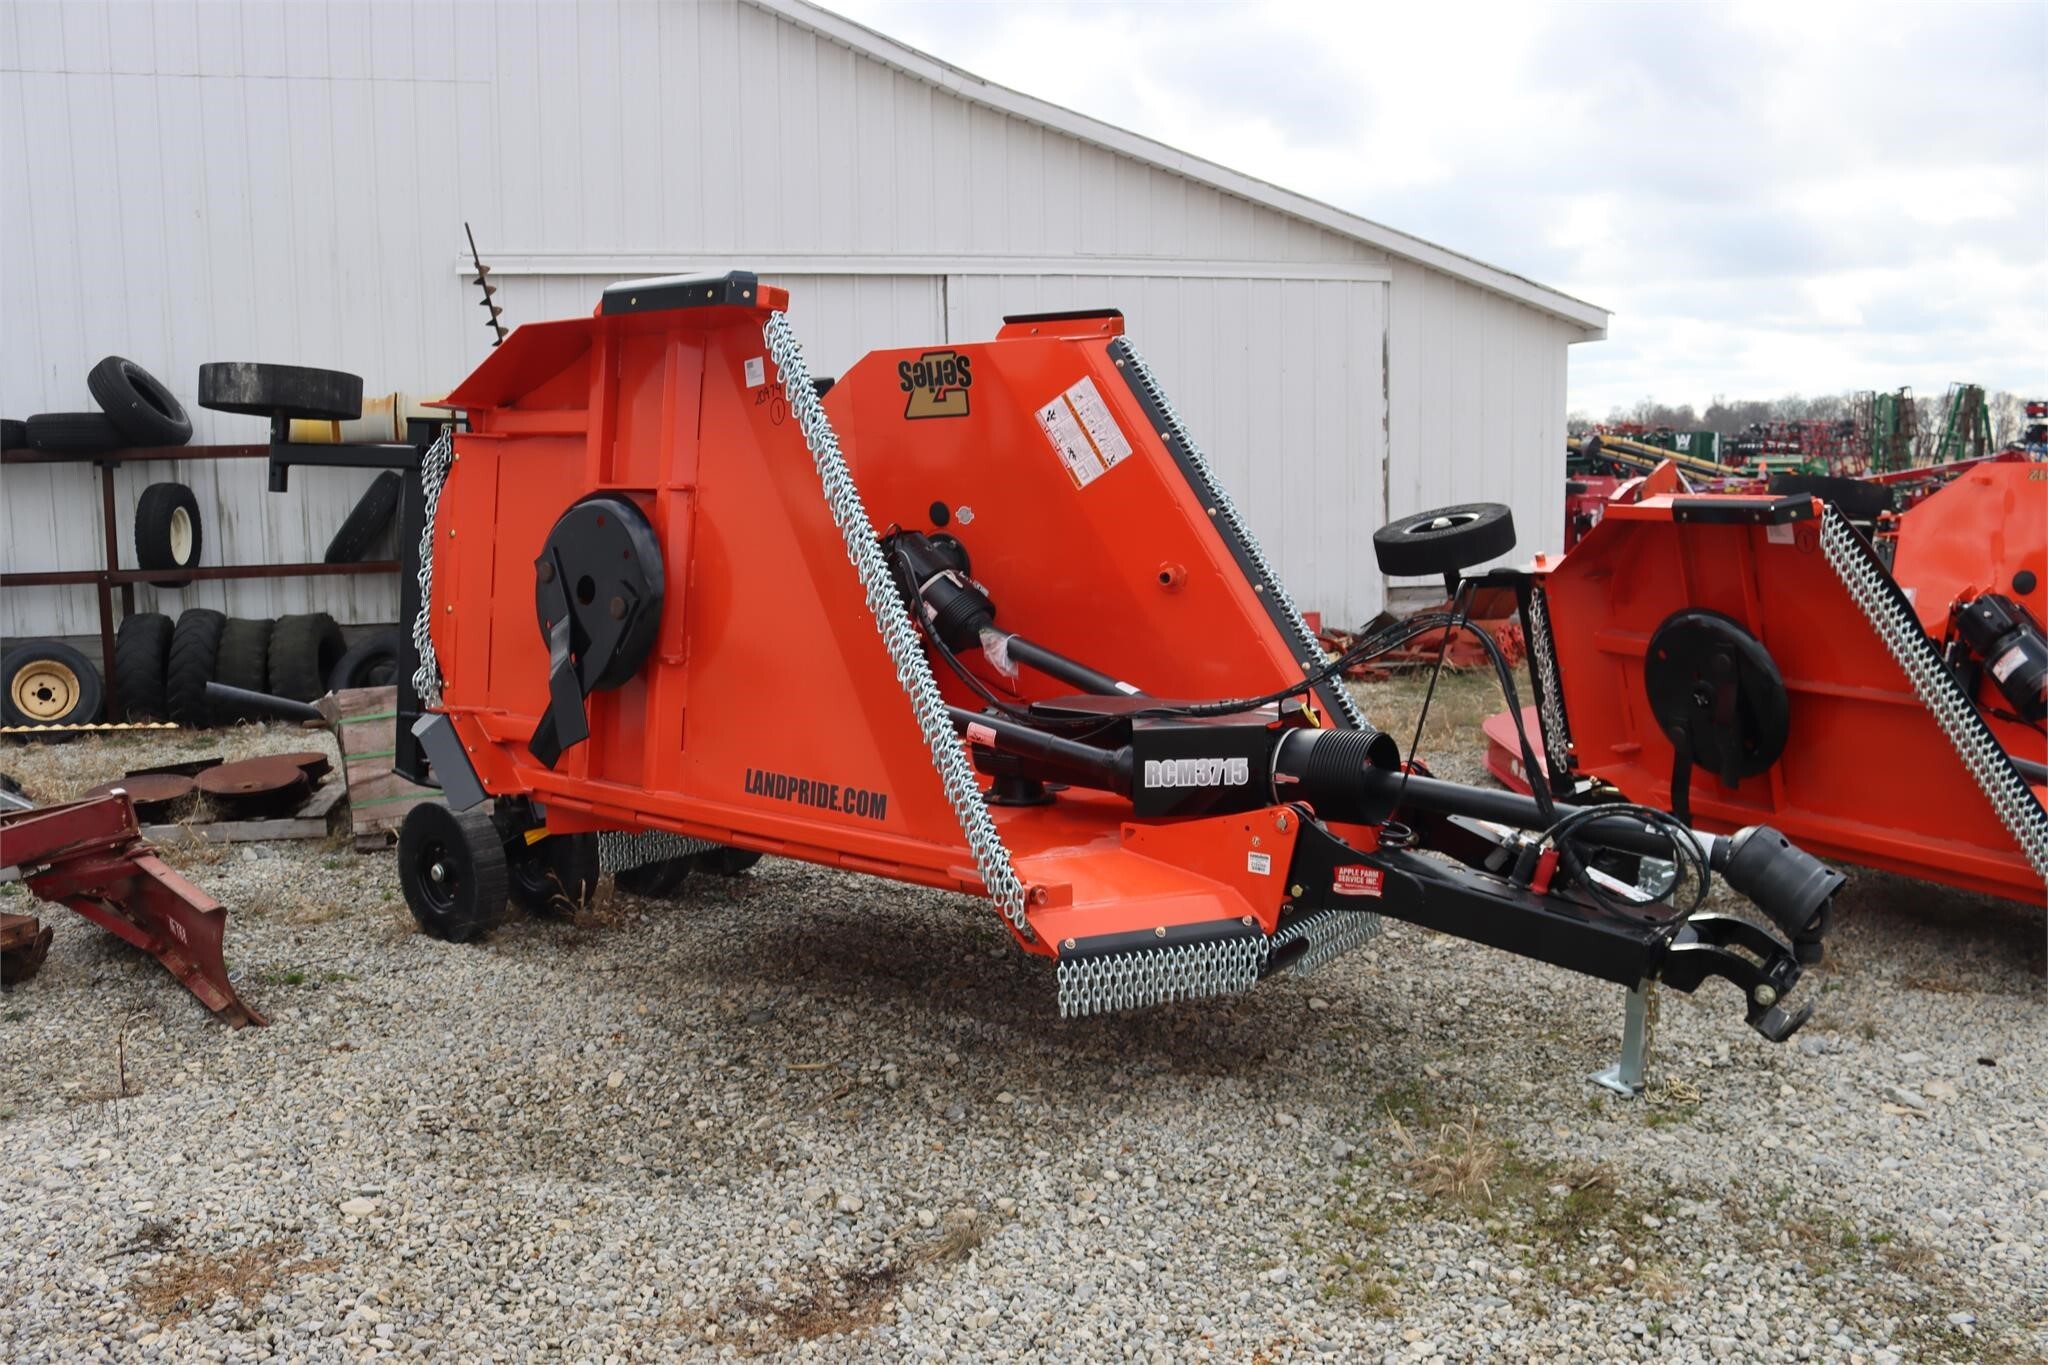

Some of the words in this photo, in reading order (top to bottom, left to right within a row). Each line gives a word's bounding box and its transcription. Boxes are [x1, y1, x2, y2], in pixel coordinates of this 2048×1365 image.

[898, 355, 972, 393] Series
[1144, 757, 1249, 788] RCM3715
[744, 767, 888, 821] LANDPRIDE.COM
[1338, 875, 1365, 884] SERVICE
[1339, 867, 1360, 877] APPLE
[1360, 869, 1379, 878] FARM
